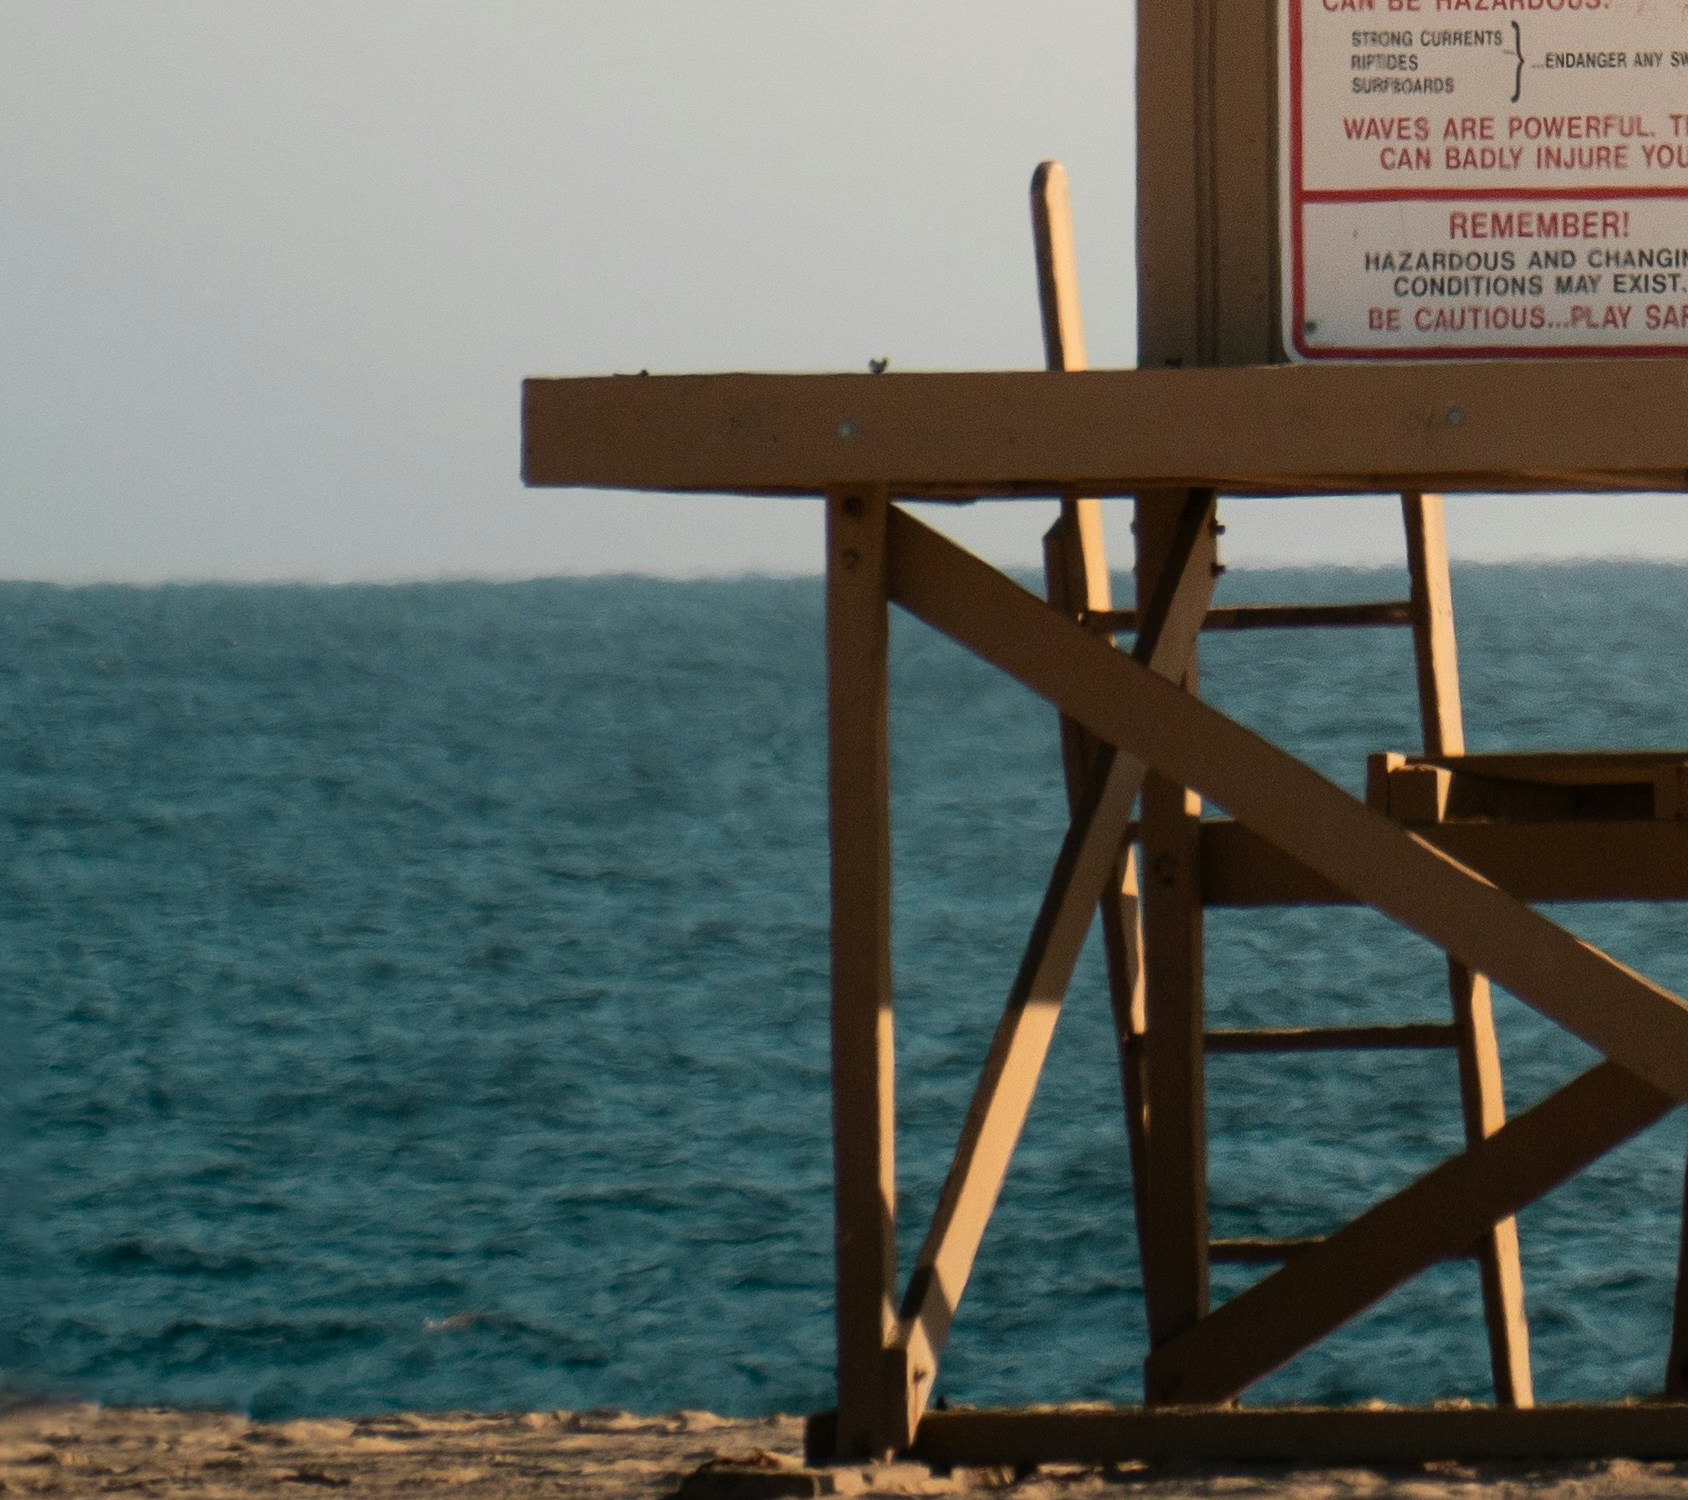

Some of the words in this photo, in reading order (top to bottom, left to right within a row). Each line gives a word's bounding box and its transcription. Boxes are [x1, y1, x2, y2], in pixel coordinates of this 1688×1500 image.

[1352, 30, 1413, 47] STRONG
[1420, 30, 1502, 47] CURRENTS
[1634, 52, 1663, 67] ANY
[1343, 117, 1429, 141] WAVES
[1443, 117, 1494, 140] ARE
[1508, 115, 1654, 139] POWERFUL.
[1380, 147, 1431, 170] CAN
[1445, 146, 1522, 170] BADLY
[1537, 145, 1627, 169] INJURE
[1450, 211, 1628, 239] REMEMBER!
[1365, 251, 1515, 272] HAZARDOUS
[1528, 250, 1576, 269] AND
[1394, 275, 1543, 297] CONDITIONS
[1555, 275, 1601, 294] MAY
[1613, 273, 1686, 294] EXIST.
[1369, 308, 1400, 332] BE
